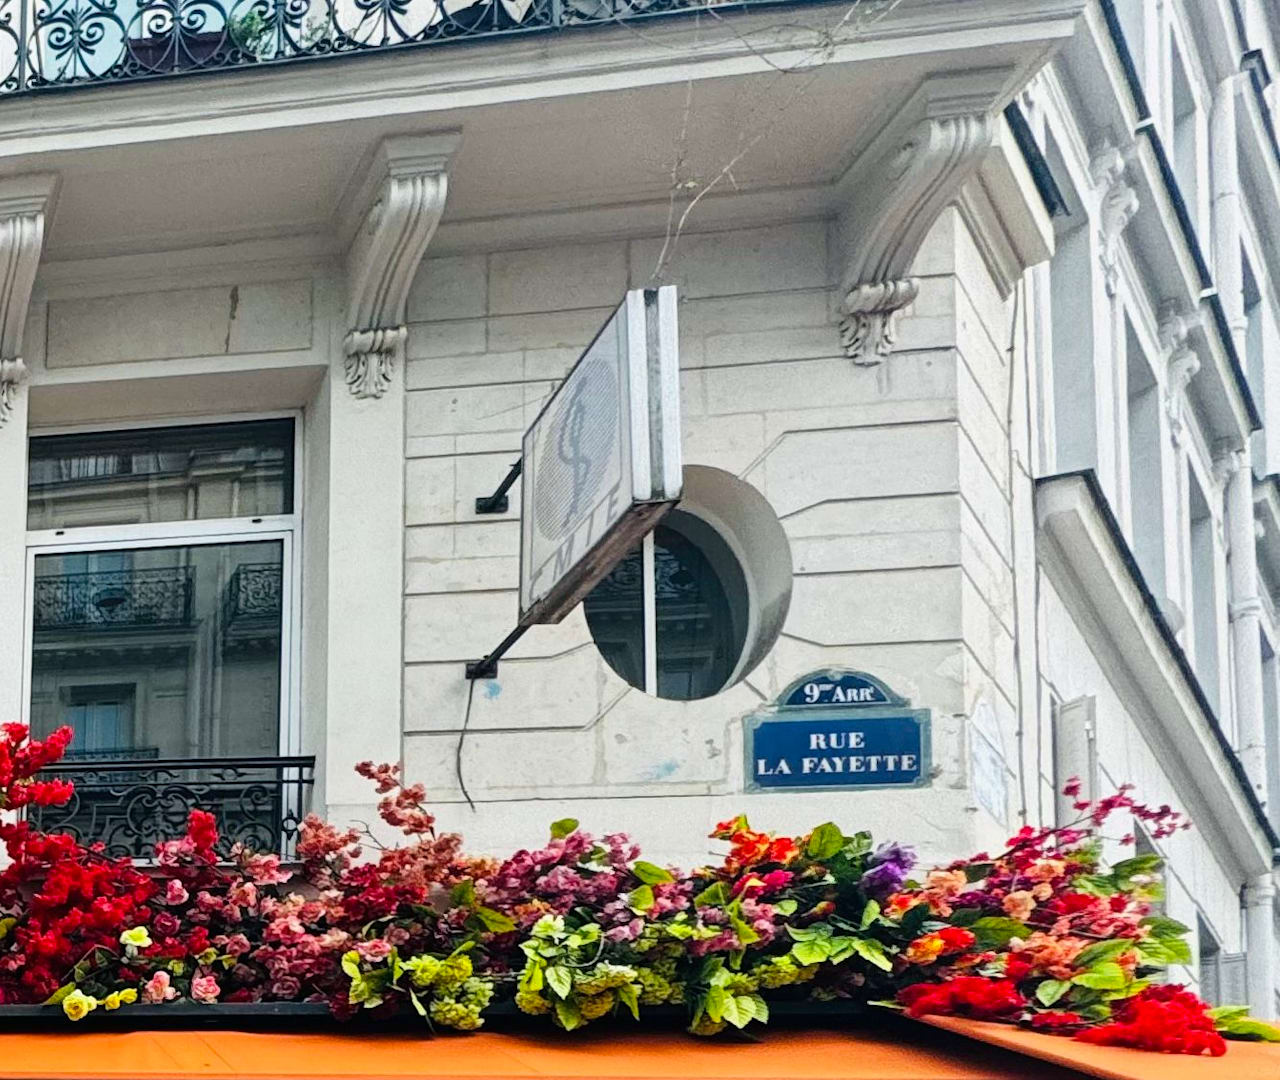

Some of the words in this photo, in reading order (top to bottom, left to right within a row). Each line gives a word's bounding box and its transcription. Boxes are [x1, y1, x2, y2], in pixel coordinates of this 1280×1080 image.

[809, 731, 865, 750] RUE
[757, 758, 792, 776] LA
[802, 754, 917, 774] FAYETTE
